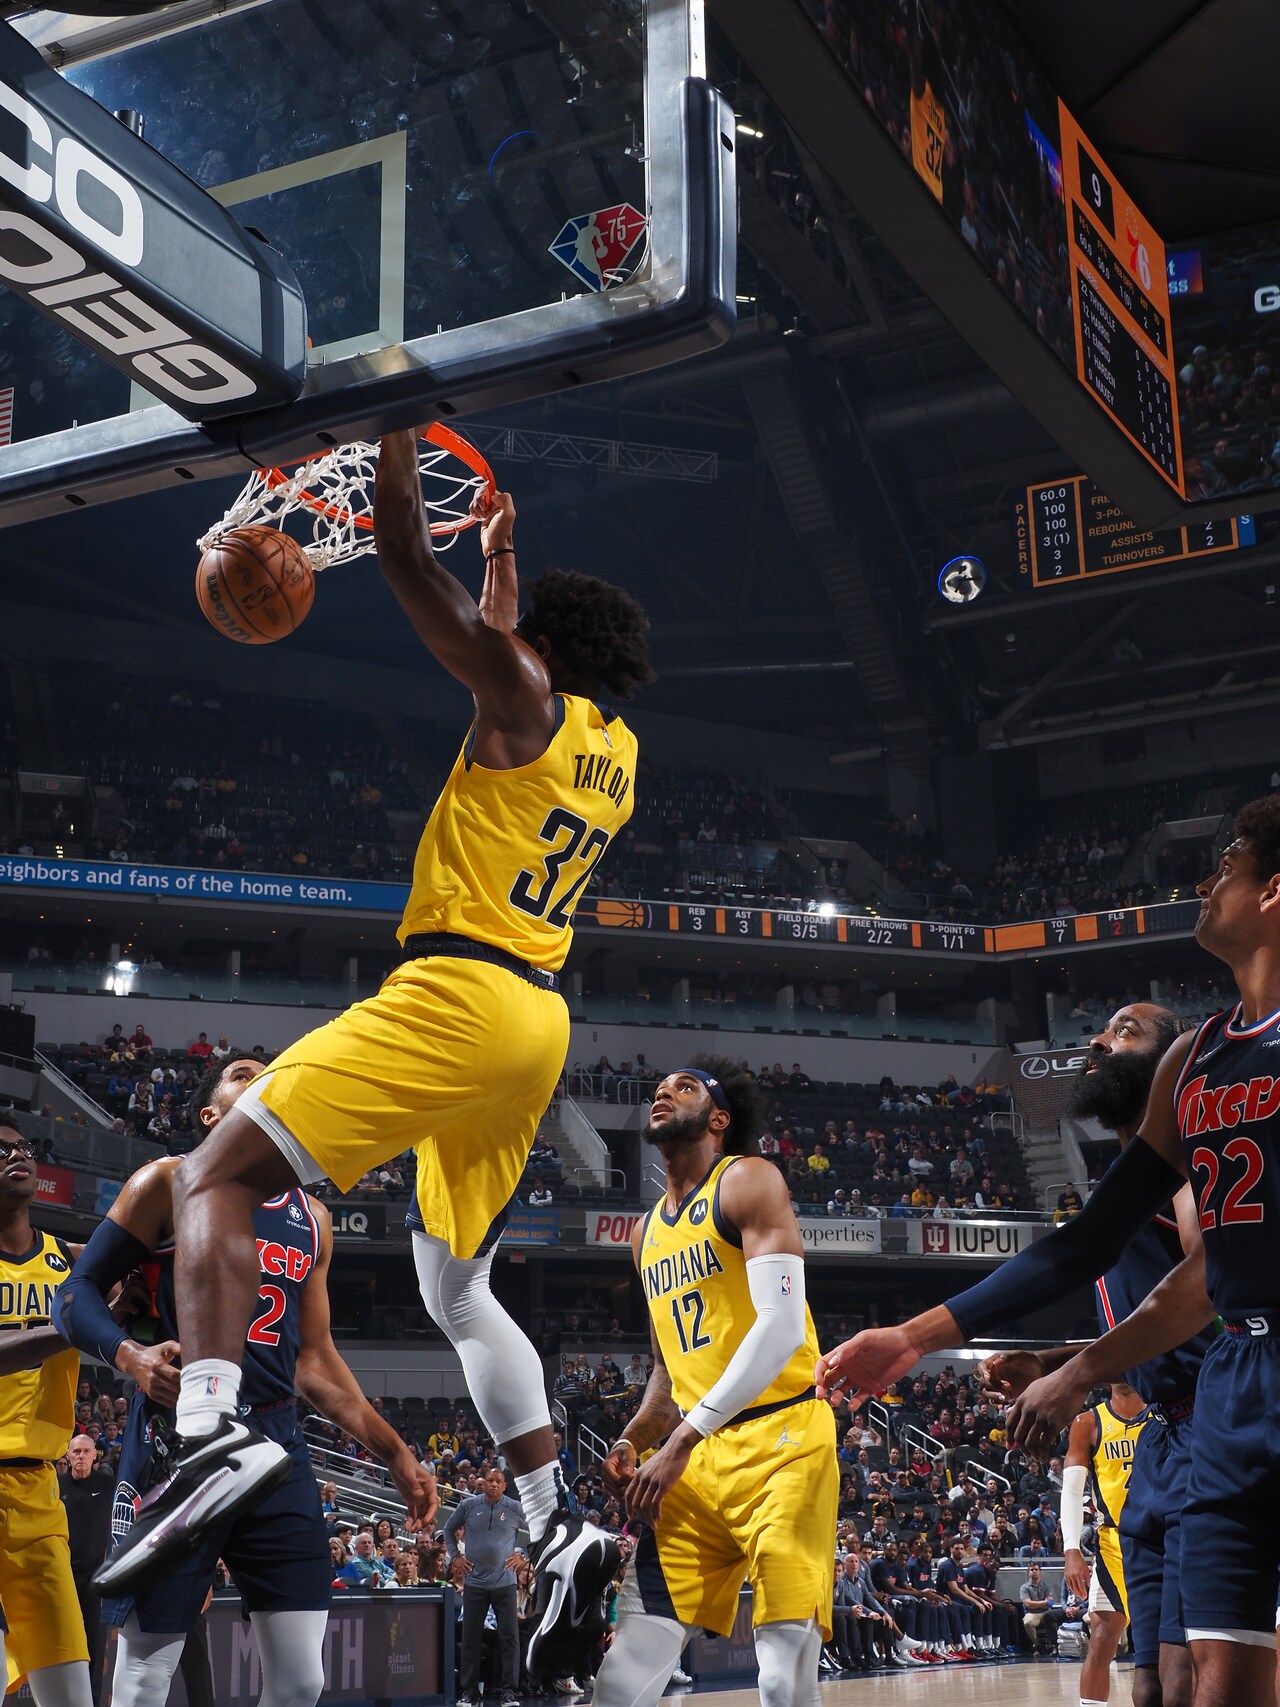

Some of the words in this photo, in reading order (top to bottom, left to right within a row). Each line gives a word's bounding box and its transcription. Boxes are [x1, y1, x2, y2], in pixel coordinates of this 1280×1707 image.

[1092, 173, 1101, 208] 9
[608, 216, 626, 243] 75
[1144, 316, 1148, 329] 2
[1156, 332, 1161, 345] 2
[1040, 488, 1066, 502] 60.0
[1044, 503, 1066, 517] 100
[1016, 503, 1028, 574] PACERS
[1045, 518, 1067, 531] 100
[1043, 536, 1051, 547] 3
[1054, 550, 1062, 560] 3
[1111, 532, 1154, 548] ASSISTS
[1055, 565, 1062, 576] 2
[1102, 546, 1164, 565] TURNOVERS
[1206, 536, 1214, 547] 2
[573, 754, 630, 810] TAYLOR
[508, 806, 610, 931] 32
[86, 869, 122, 885] and
[129, 870, 169, 888] fans
[175, 875, 196, 890] of
[202, 876, 233, 893] the
[240, 878, 293, 897] home
[299, 884, 352, 901] team.
[688, 907, 706, 916] REB
[735, 911, 752, 919] AST
[778, 913, 801, 923] FIELD
[803, 916, 831, 925] GOALS
[850, 919, 871, 928] FREE
[873, 921, 908, 931] THROWS
[929, 925, 961, 935] 3-POINT
[964, 927, 975, 935] FG
[693, 917, 702, 931] 3
[739, 920, 749, 934] 3
[792, 924, 818, 939] 3/5
[867, 929, 893, 944] 2/2
[941, 934, 964, 949] 1/1
[1051, 920, 1068, 929] TOL
[1108, 912, 1125, 921] FLS
[1055, 929, 1065, 943] 7
[1113, 921, 1121, 936] 2
[1192, 1137, 1264, 1233] 22
[955, 1227, 1019, 1253] IUPUI
[642, 1238, 724, 1302] INDIANA
[671, 1289, 712, 1355] 12
[230, 1618, 364, 1698] MTH
[388, 1653, 411, 1667] planet
[391, 1664, 415, 1675] fitness
